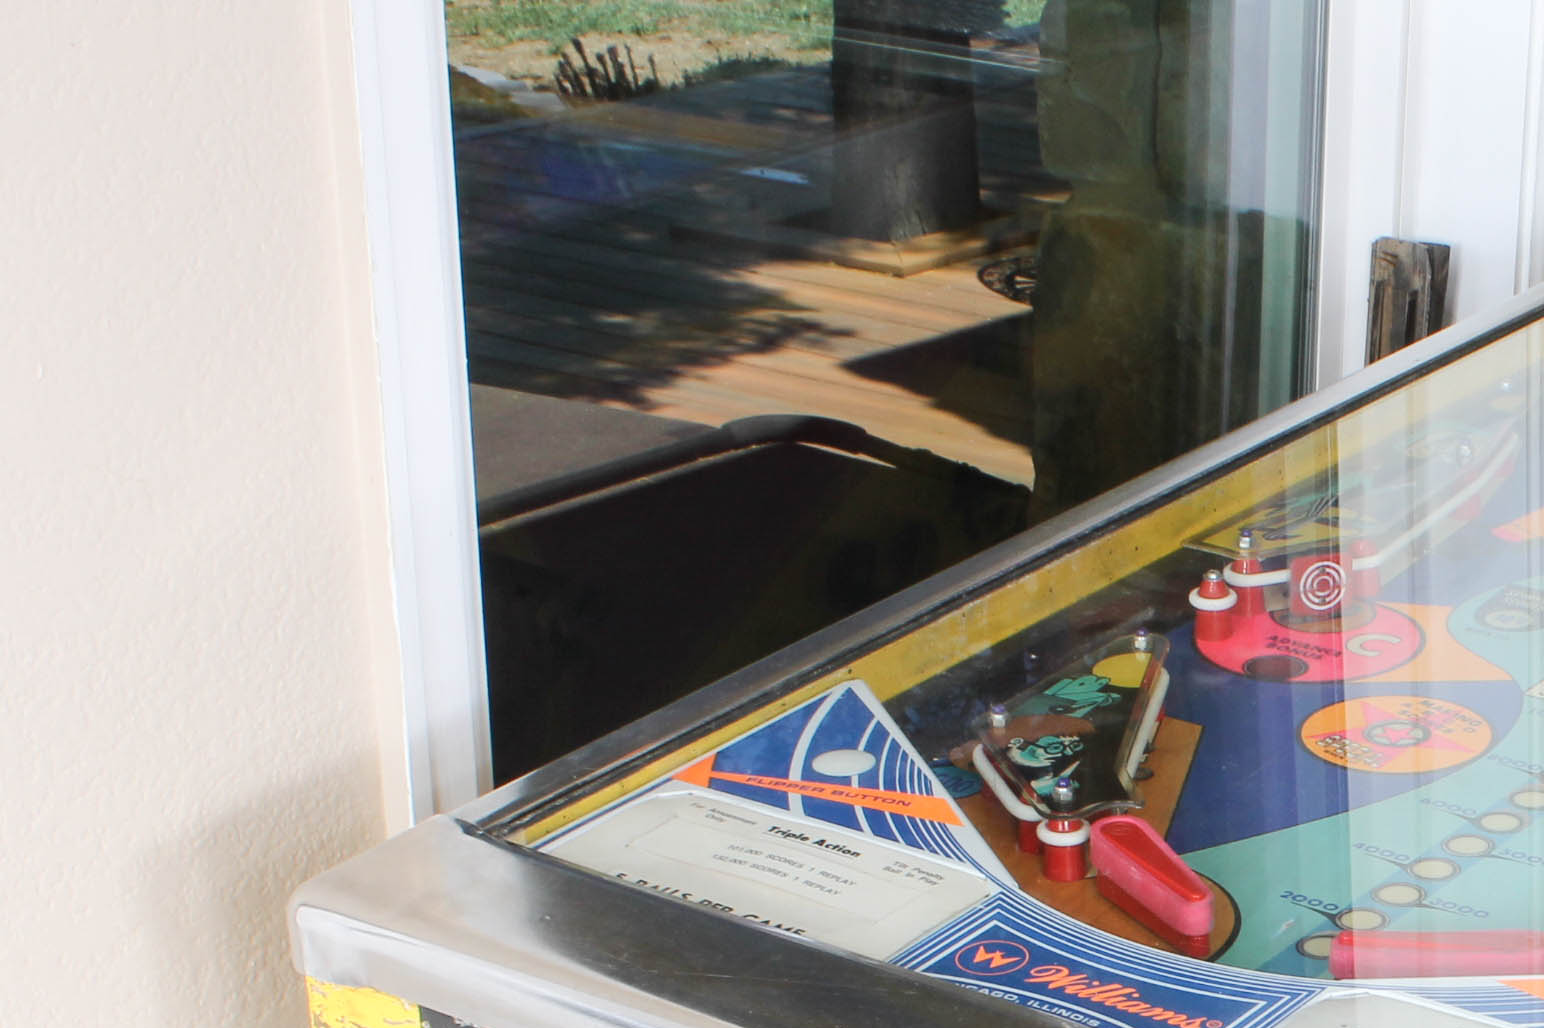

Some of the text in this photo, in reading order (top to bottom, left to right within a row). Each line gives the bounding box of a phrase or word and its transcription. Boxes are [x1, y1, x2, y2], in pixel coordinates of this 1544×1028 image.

[745, 776, 912, 807] FLIPPER BUTTON
[768, 824, 862, 859] Triple Action
[1280, 890, 1341, 912] 2000
[1027, 999, 1100, 1028] ILLINOIS
